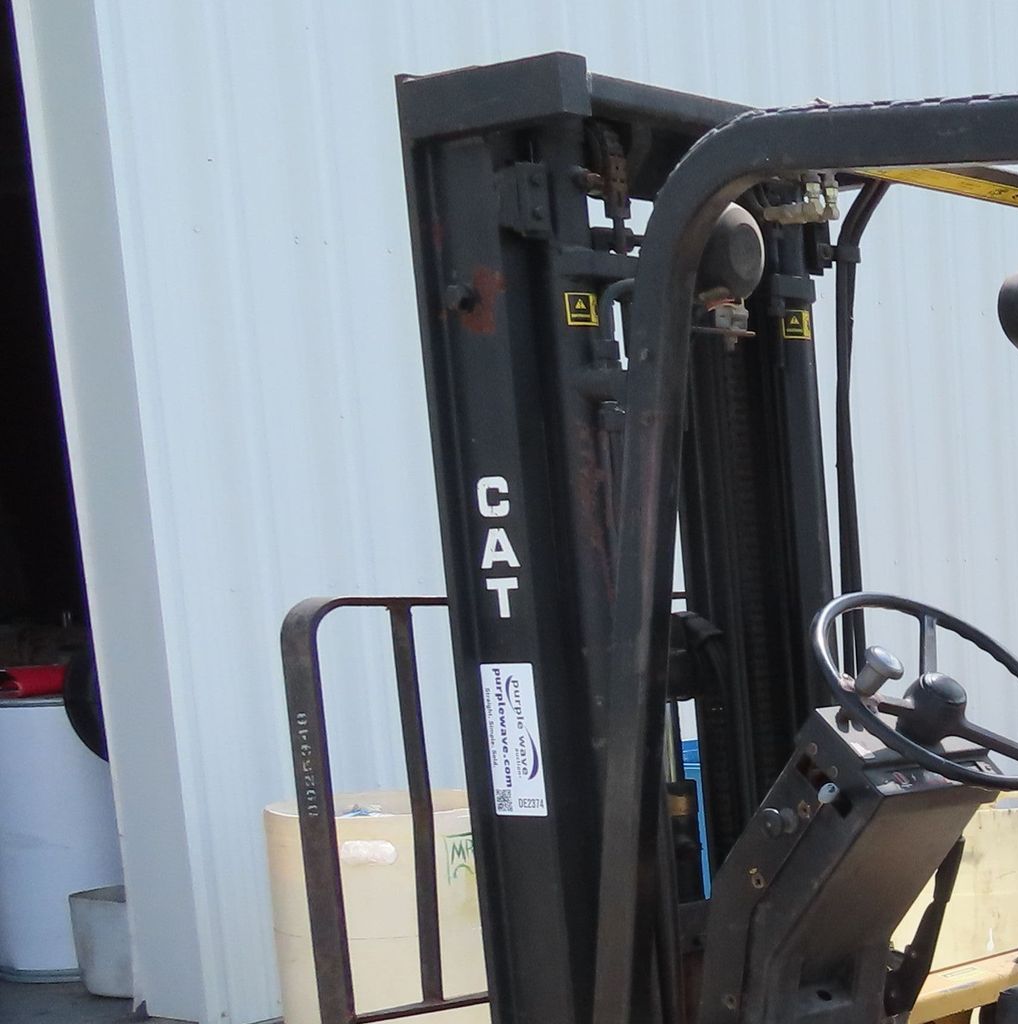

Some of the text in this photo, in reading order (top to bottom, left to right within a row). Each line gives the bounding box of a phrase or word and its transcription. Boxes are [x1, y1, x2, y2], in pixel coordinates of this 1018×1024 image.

[477, 476, 521, 618] CAT
[491, 668, 513, 788] purplewave.com
[511, 679, 529, 776] purple wave
